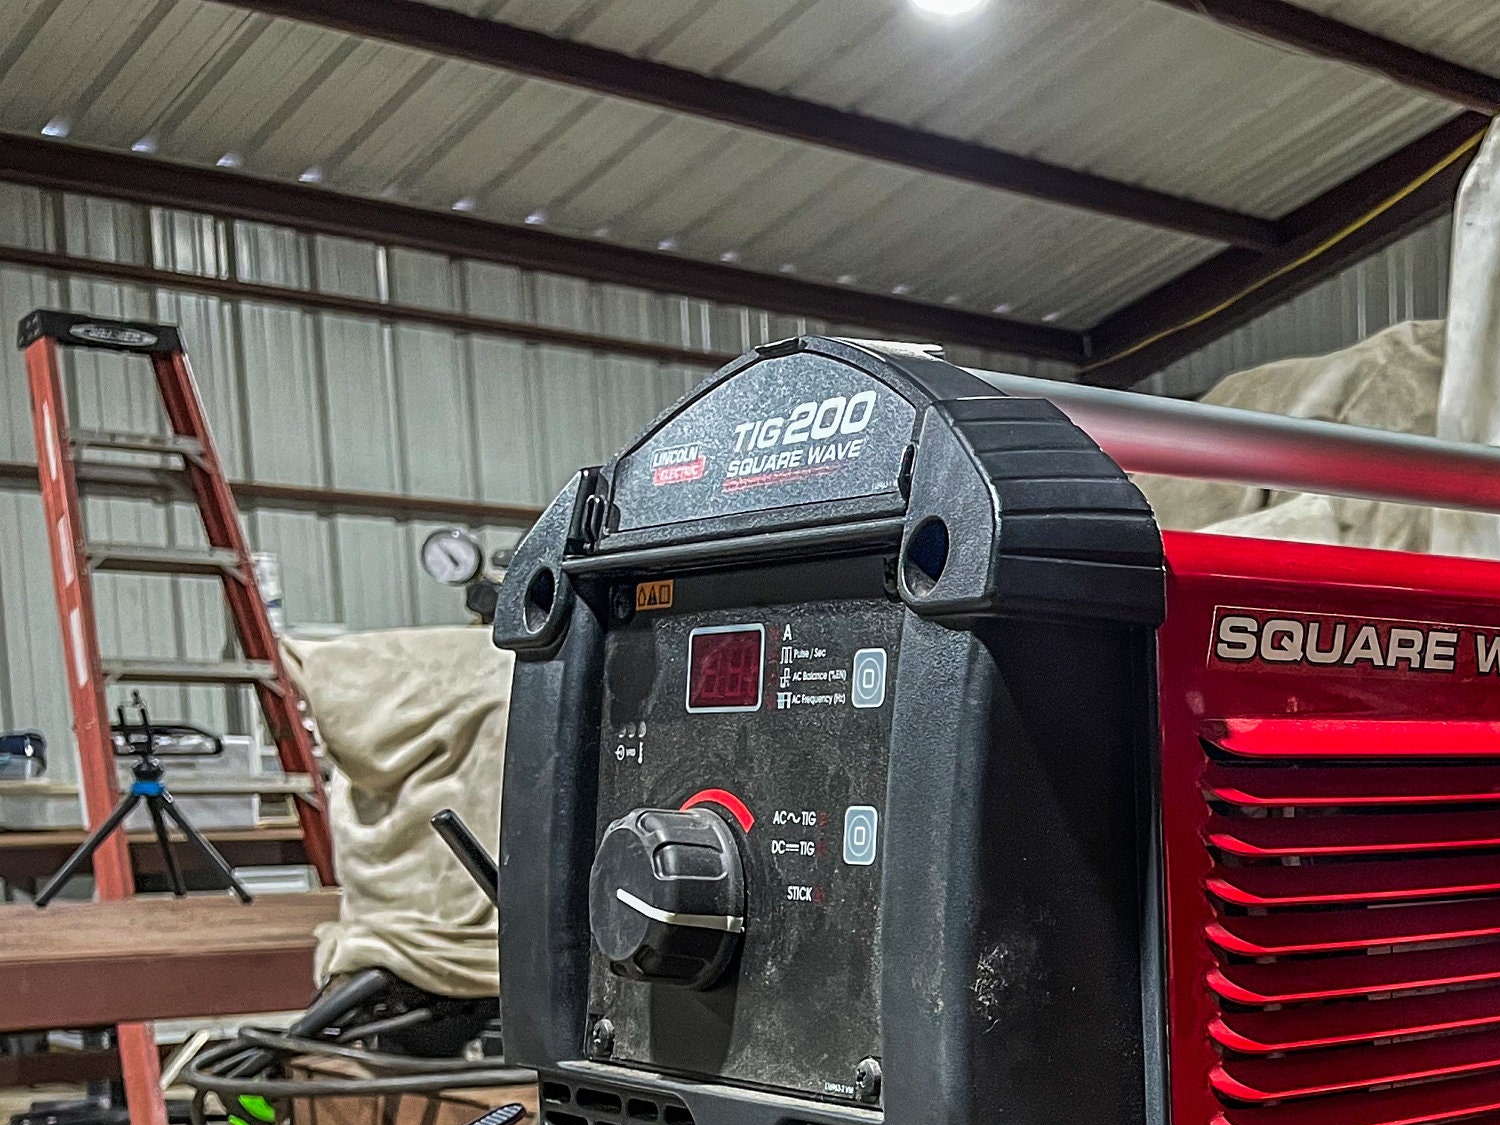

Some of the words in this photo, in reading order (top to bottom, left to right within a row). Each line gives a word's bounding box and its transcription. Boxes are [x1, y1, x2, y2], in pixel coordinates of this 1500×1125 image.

[653, 446, 699, 467] LINCOLN
[726, 453, 802, 479] SQUARE
[807, 439, 865, 466] WAVE
[782, 624, 793, 641] A
[1216, 615, 1458, 671] SQUARE
[814, 648, 826, 658] Sec
[792, 671, 802, 681] AC
[803, 670, 827, 680] Balance
[792, 694, 801, 704] AC
[802, 693, 833, 705] Frequency
[787, 885, 812, 902] STICK
